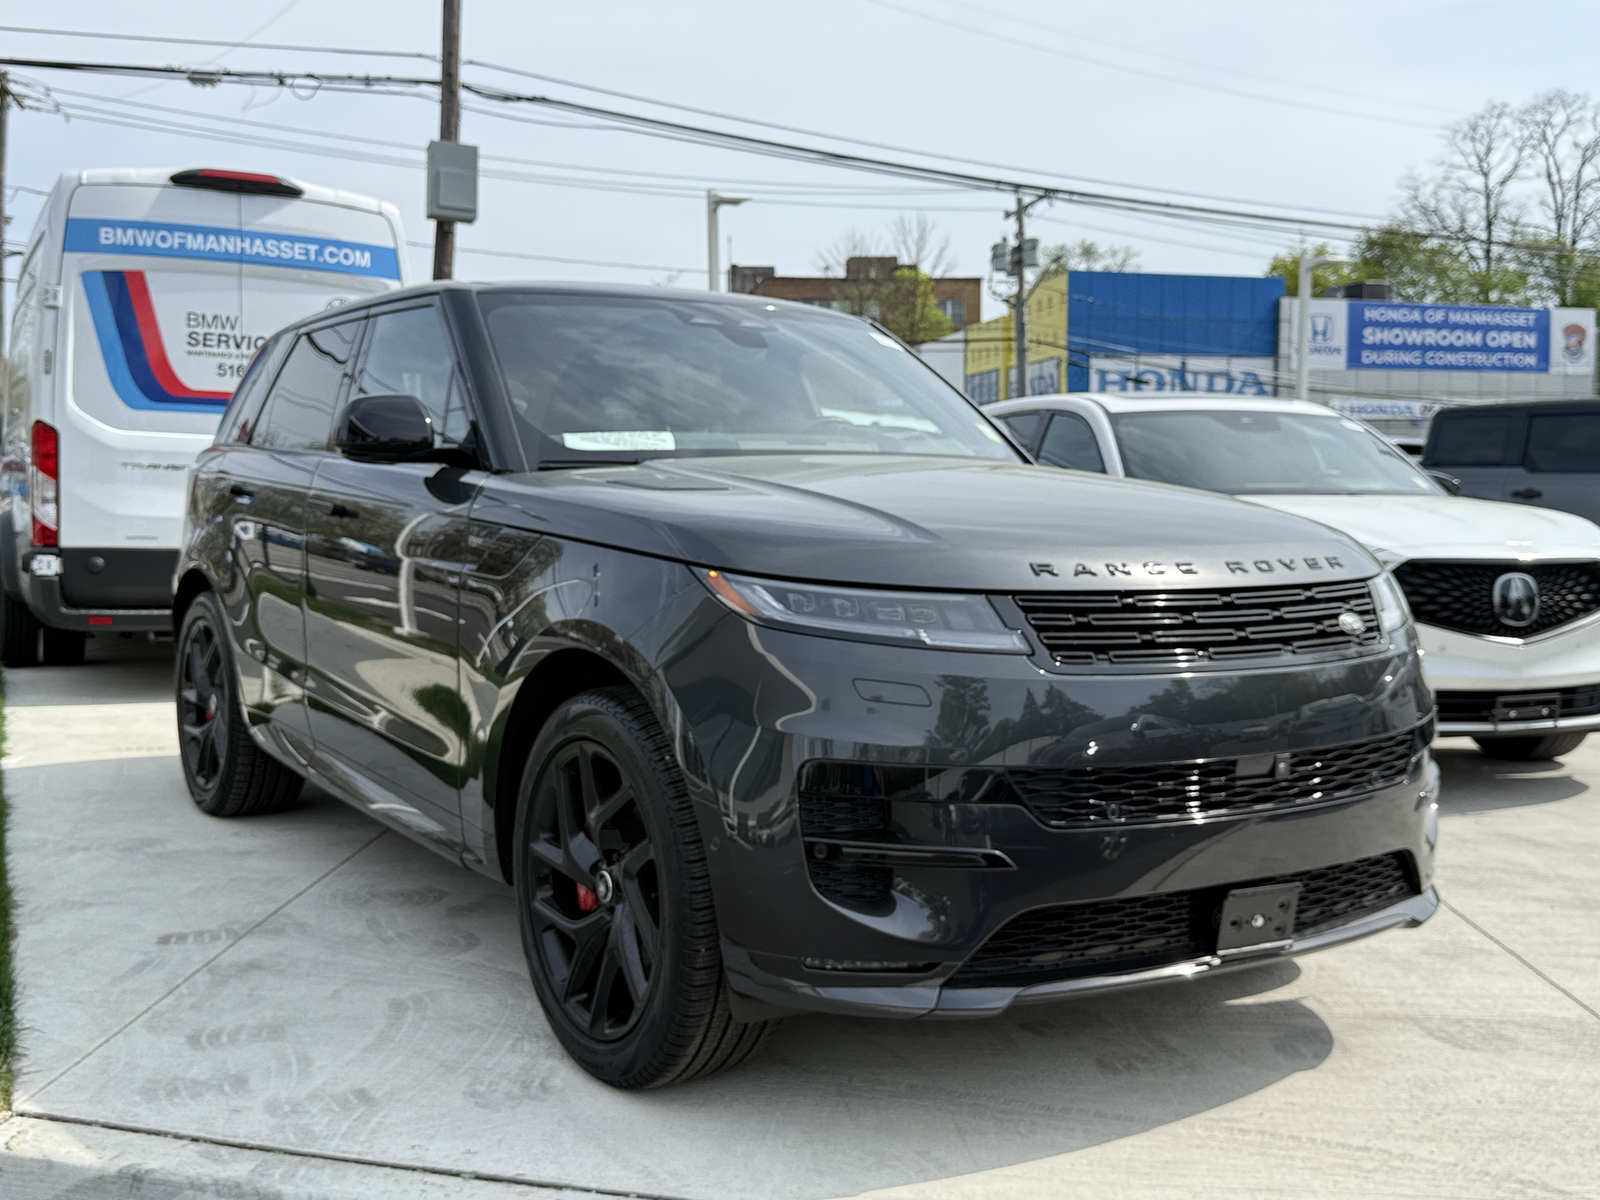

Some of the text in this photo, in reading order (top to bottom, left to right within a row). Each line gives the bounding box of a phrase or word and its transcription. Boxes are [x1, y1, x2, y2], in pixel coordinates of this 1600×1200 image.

[98, 226, 371, 268] BMWOFMANHASSET.COM
[186, 311, 239, 331] BMW
[1363, 306, 1536, 327] HONDA OF MANHASSET
[1362, 326, 1537, 349] SHOWROOM OPEN
[1361, 349, 1537, 368] DURING CONSTRUCTION
[1096, 369, 1269, 395] HONDA
[1029, 555, 1345, 577] RANGE ROVER
